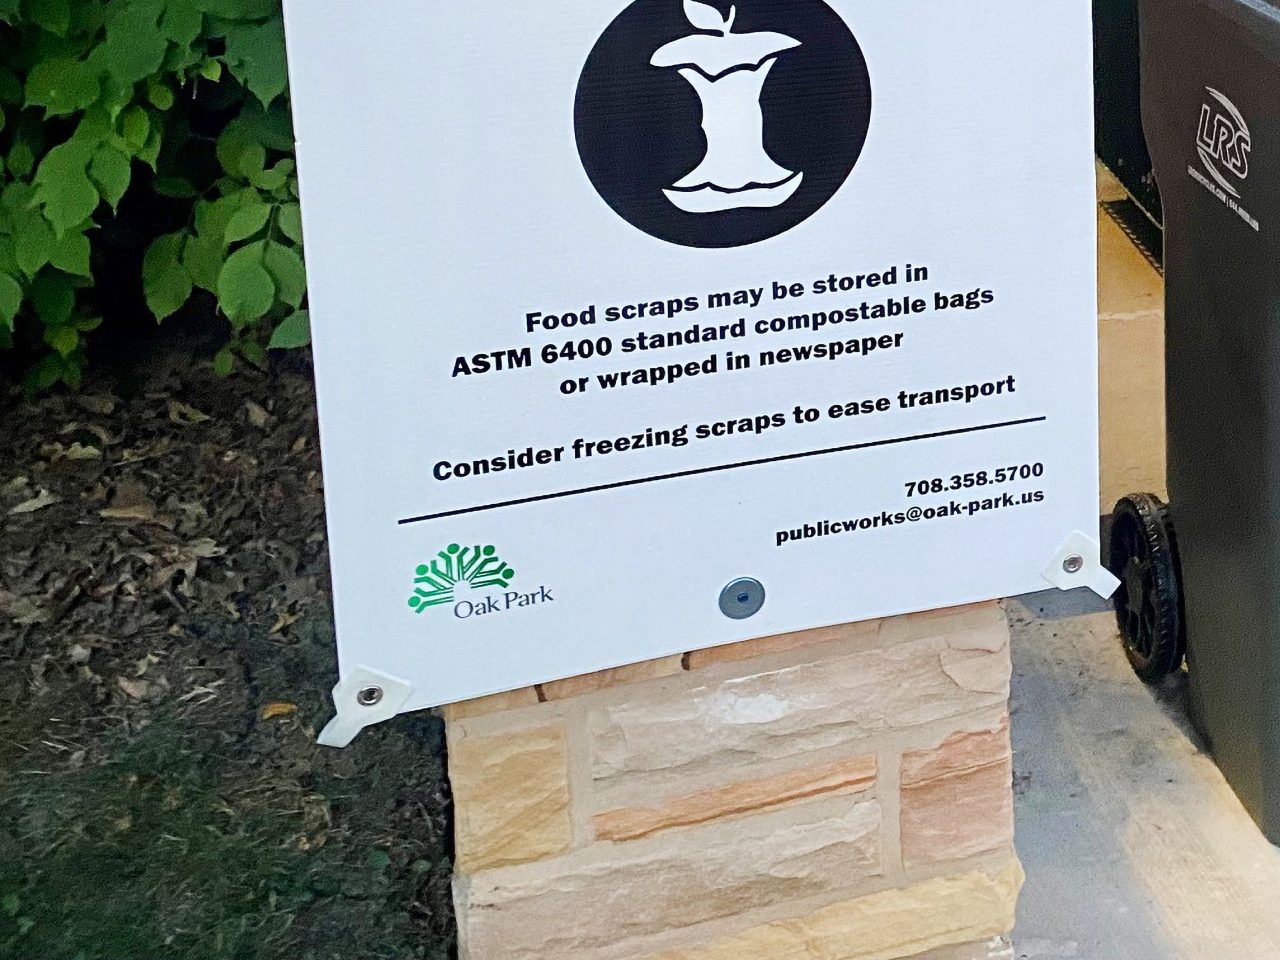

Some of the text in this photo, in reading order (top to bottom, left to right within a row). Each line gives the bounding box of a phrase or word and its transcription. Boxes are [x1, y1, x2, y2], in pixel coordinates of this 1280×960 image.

[1196, 103, 1251, 180] LRS
[526, 263, 928, 333] Food scraps may be stored in
[451, 287, 994, 378] ASTM 6400 standard compostable bags
[559, 332, 904, 395] or wrapped in newspaper
[432, 376, 1016, 481] Consider freezing scraps to ease transport
[904, 462, 1044, 498] 708.358.5700
[776, 490, 1045, 547] publicworks@oak-park.us
[453, 586, 554, 619] Oak Park
